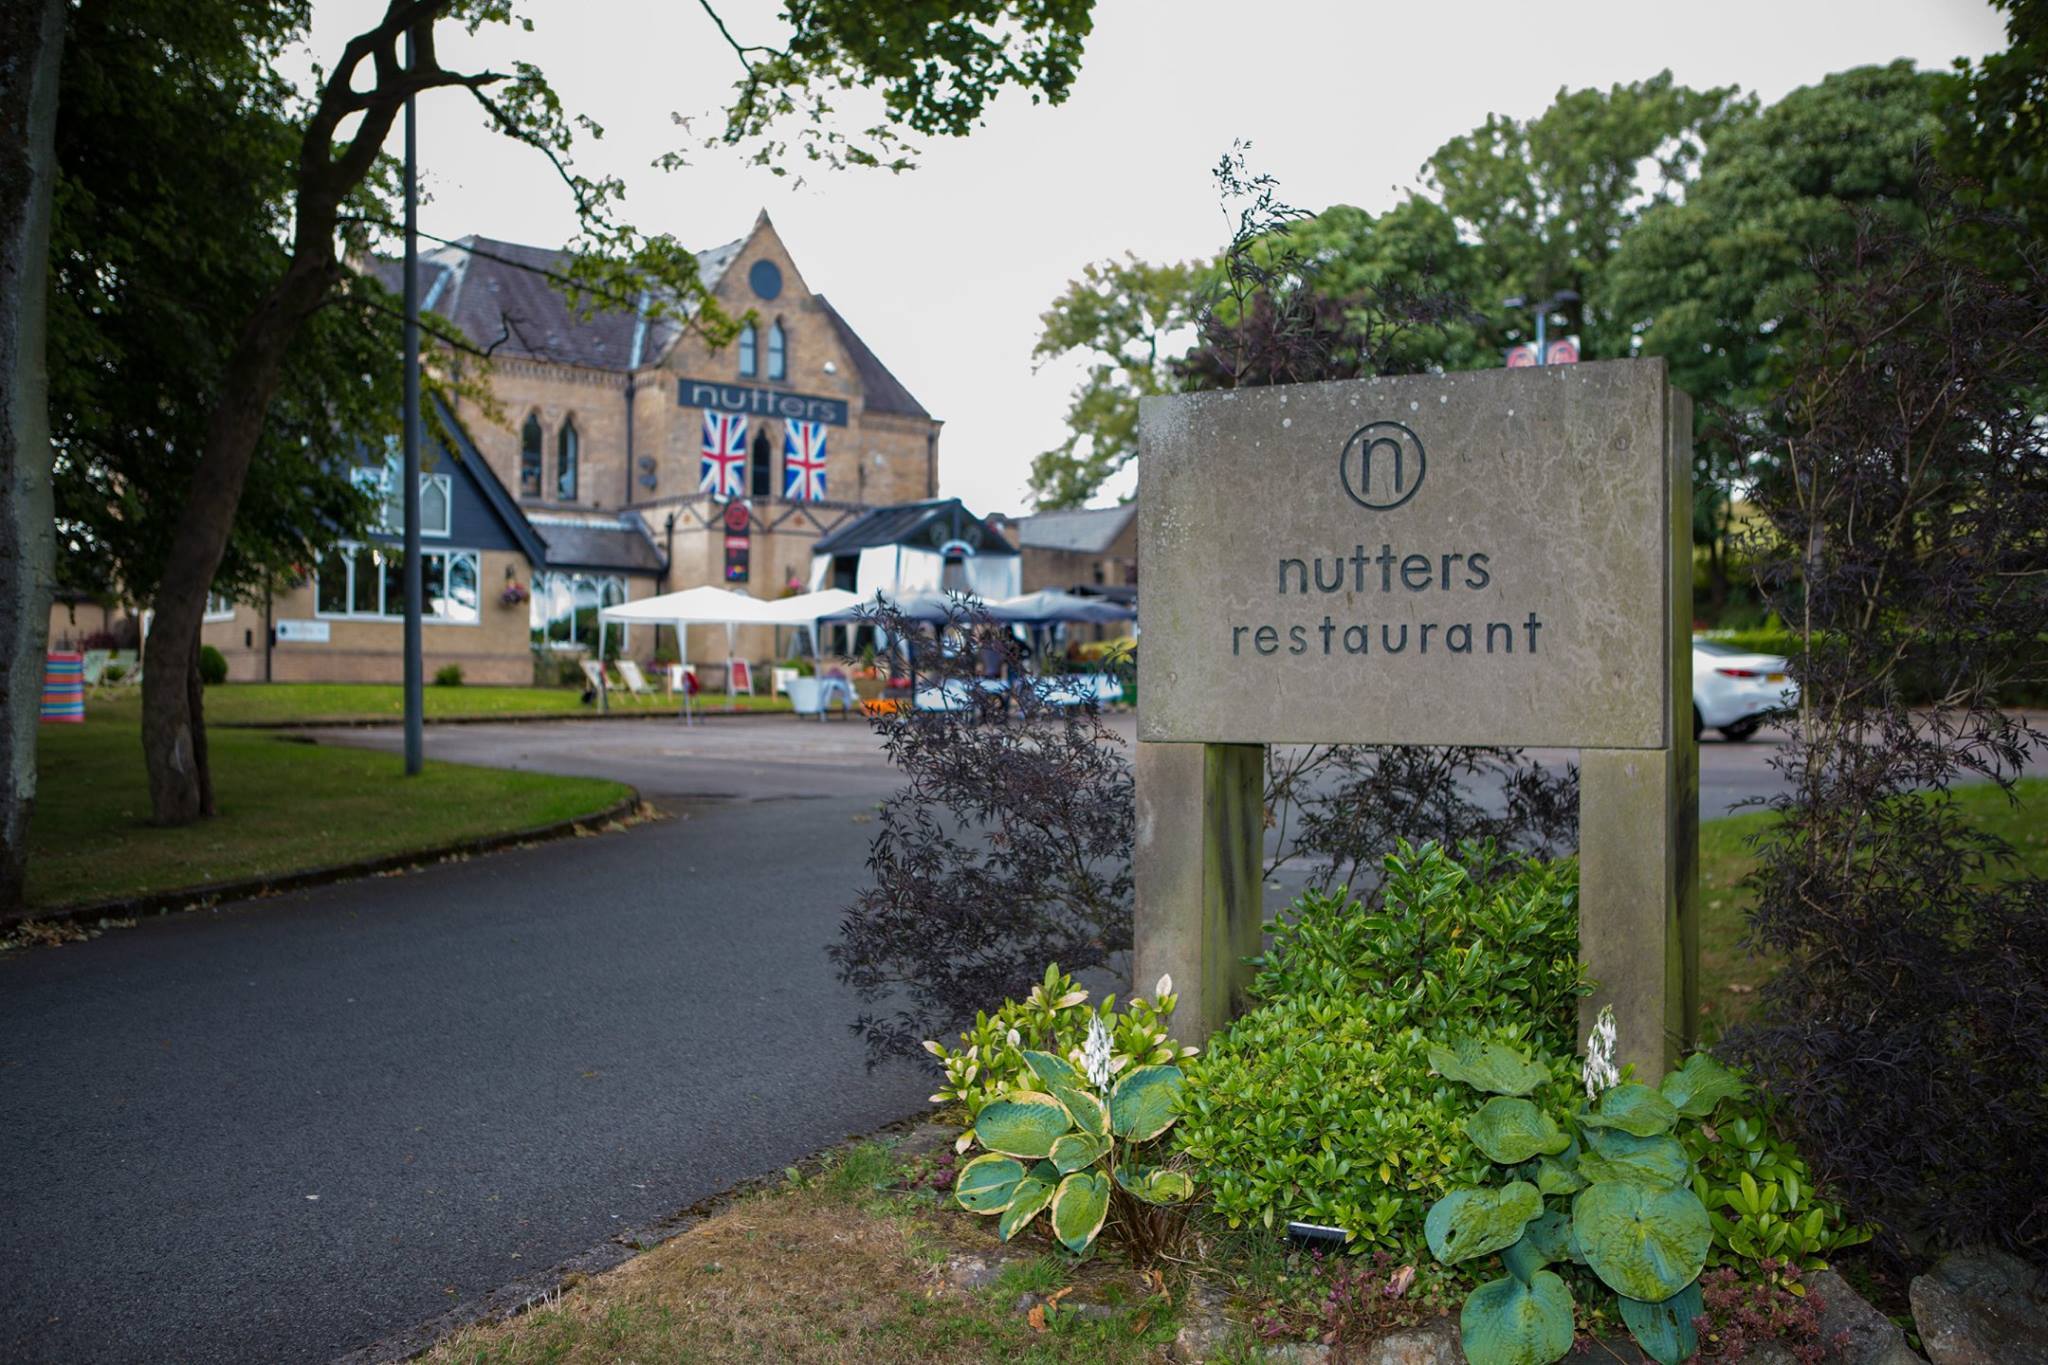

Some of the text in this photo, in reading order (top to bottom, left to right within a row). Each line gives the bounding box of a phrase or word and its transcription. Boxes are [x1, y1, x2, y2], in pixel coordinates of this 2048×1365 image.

[692, 384, 837, 422] nutters
[1361, 437, 1404, 495] n
[1278, 544, 1491, 594] nutters
[1232, 612, 1543, 657] restaurant
